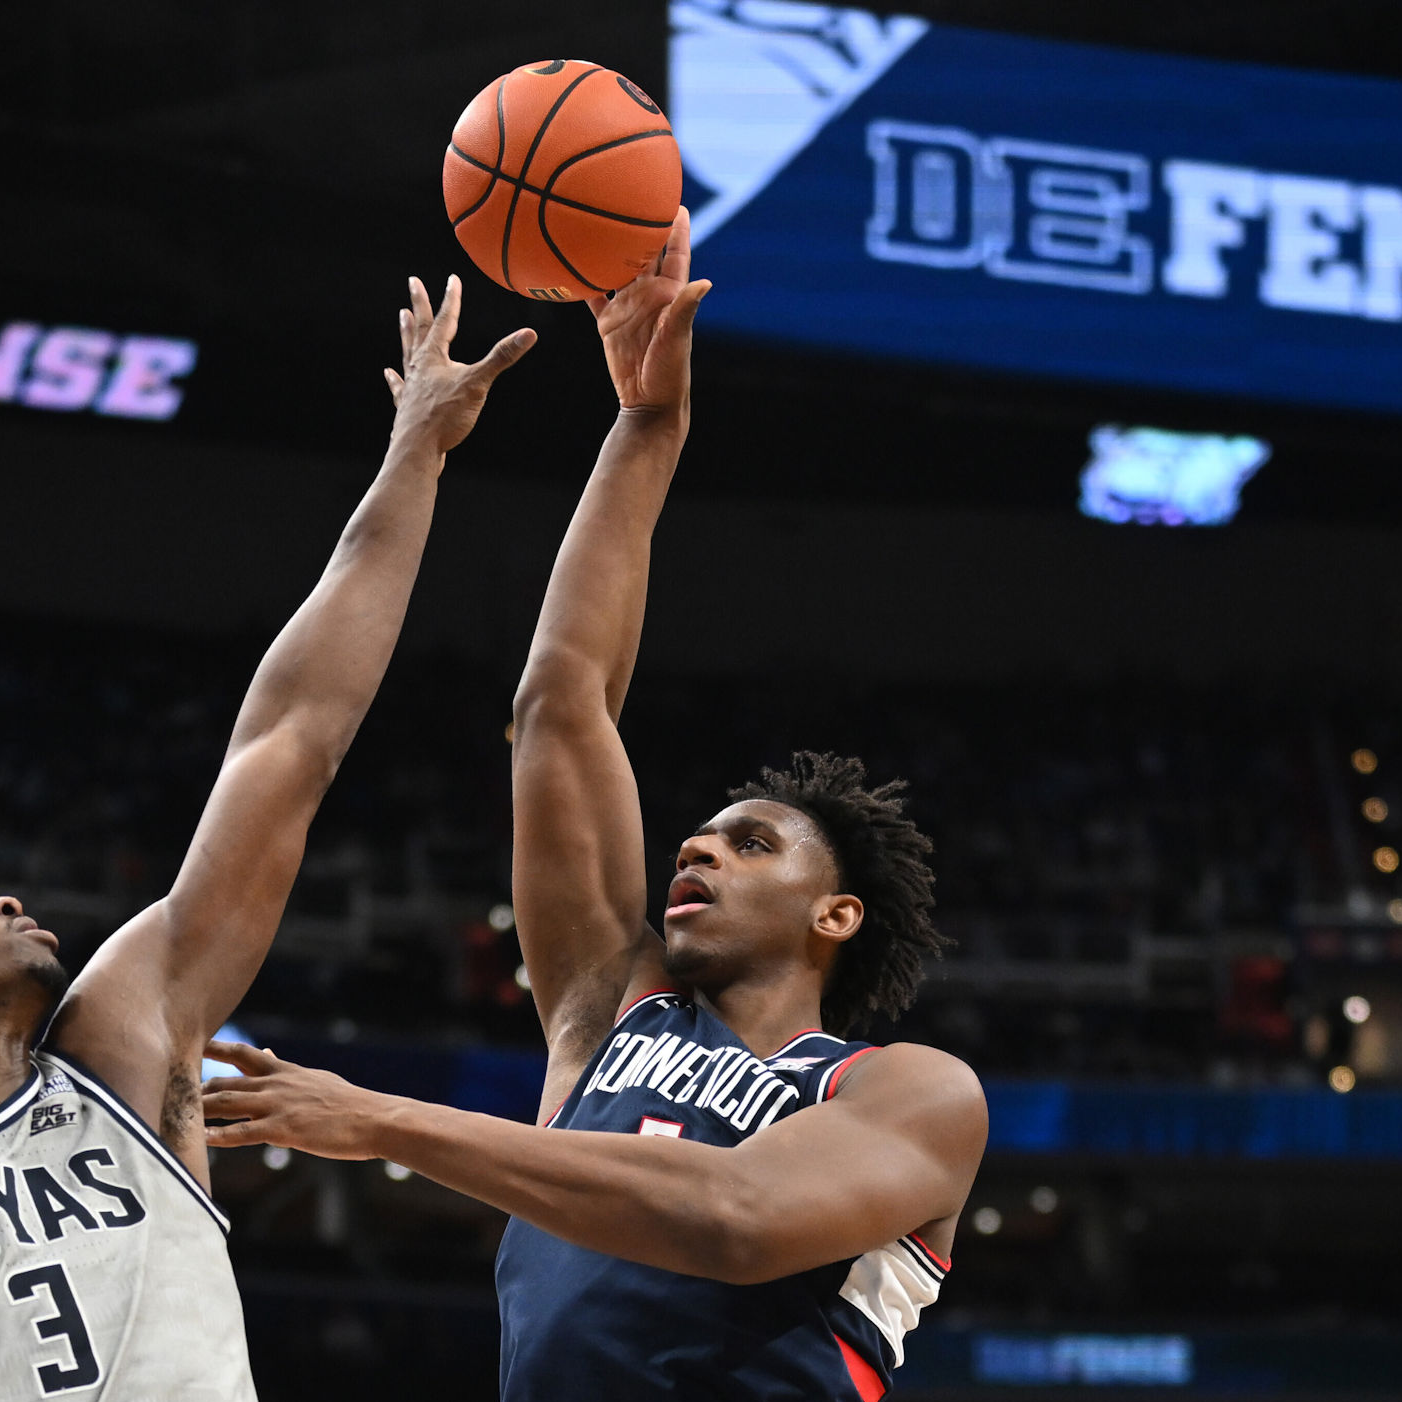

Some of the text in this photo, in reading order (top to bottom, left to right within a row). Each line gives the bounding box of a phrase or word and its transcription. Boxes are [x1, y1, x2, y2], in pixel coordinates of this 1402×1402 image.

[32, 1103, 63, 1120] BIG
[31, 1112, 76, 1132] EAST
[8, 1261, 100, 1396] 3
